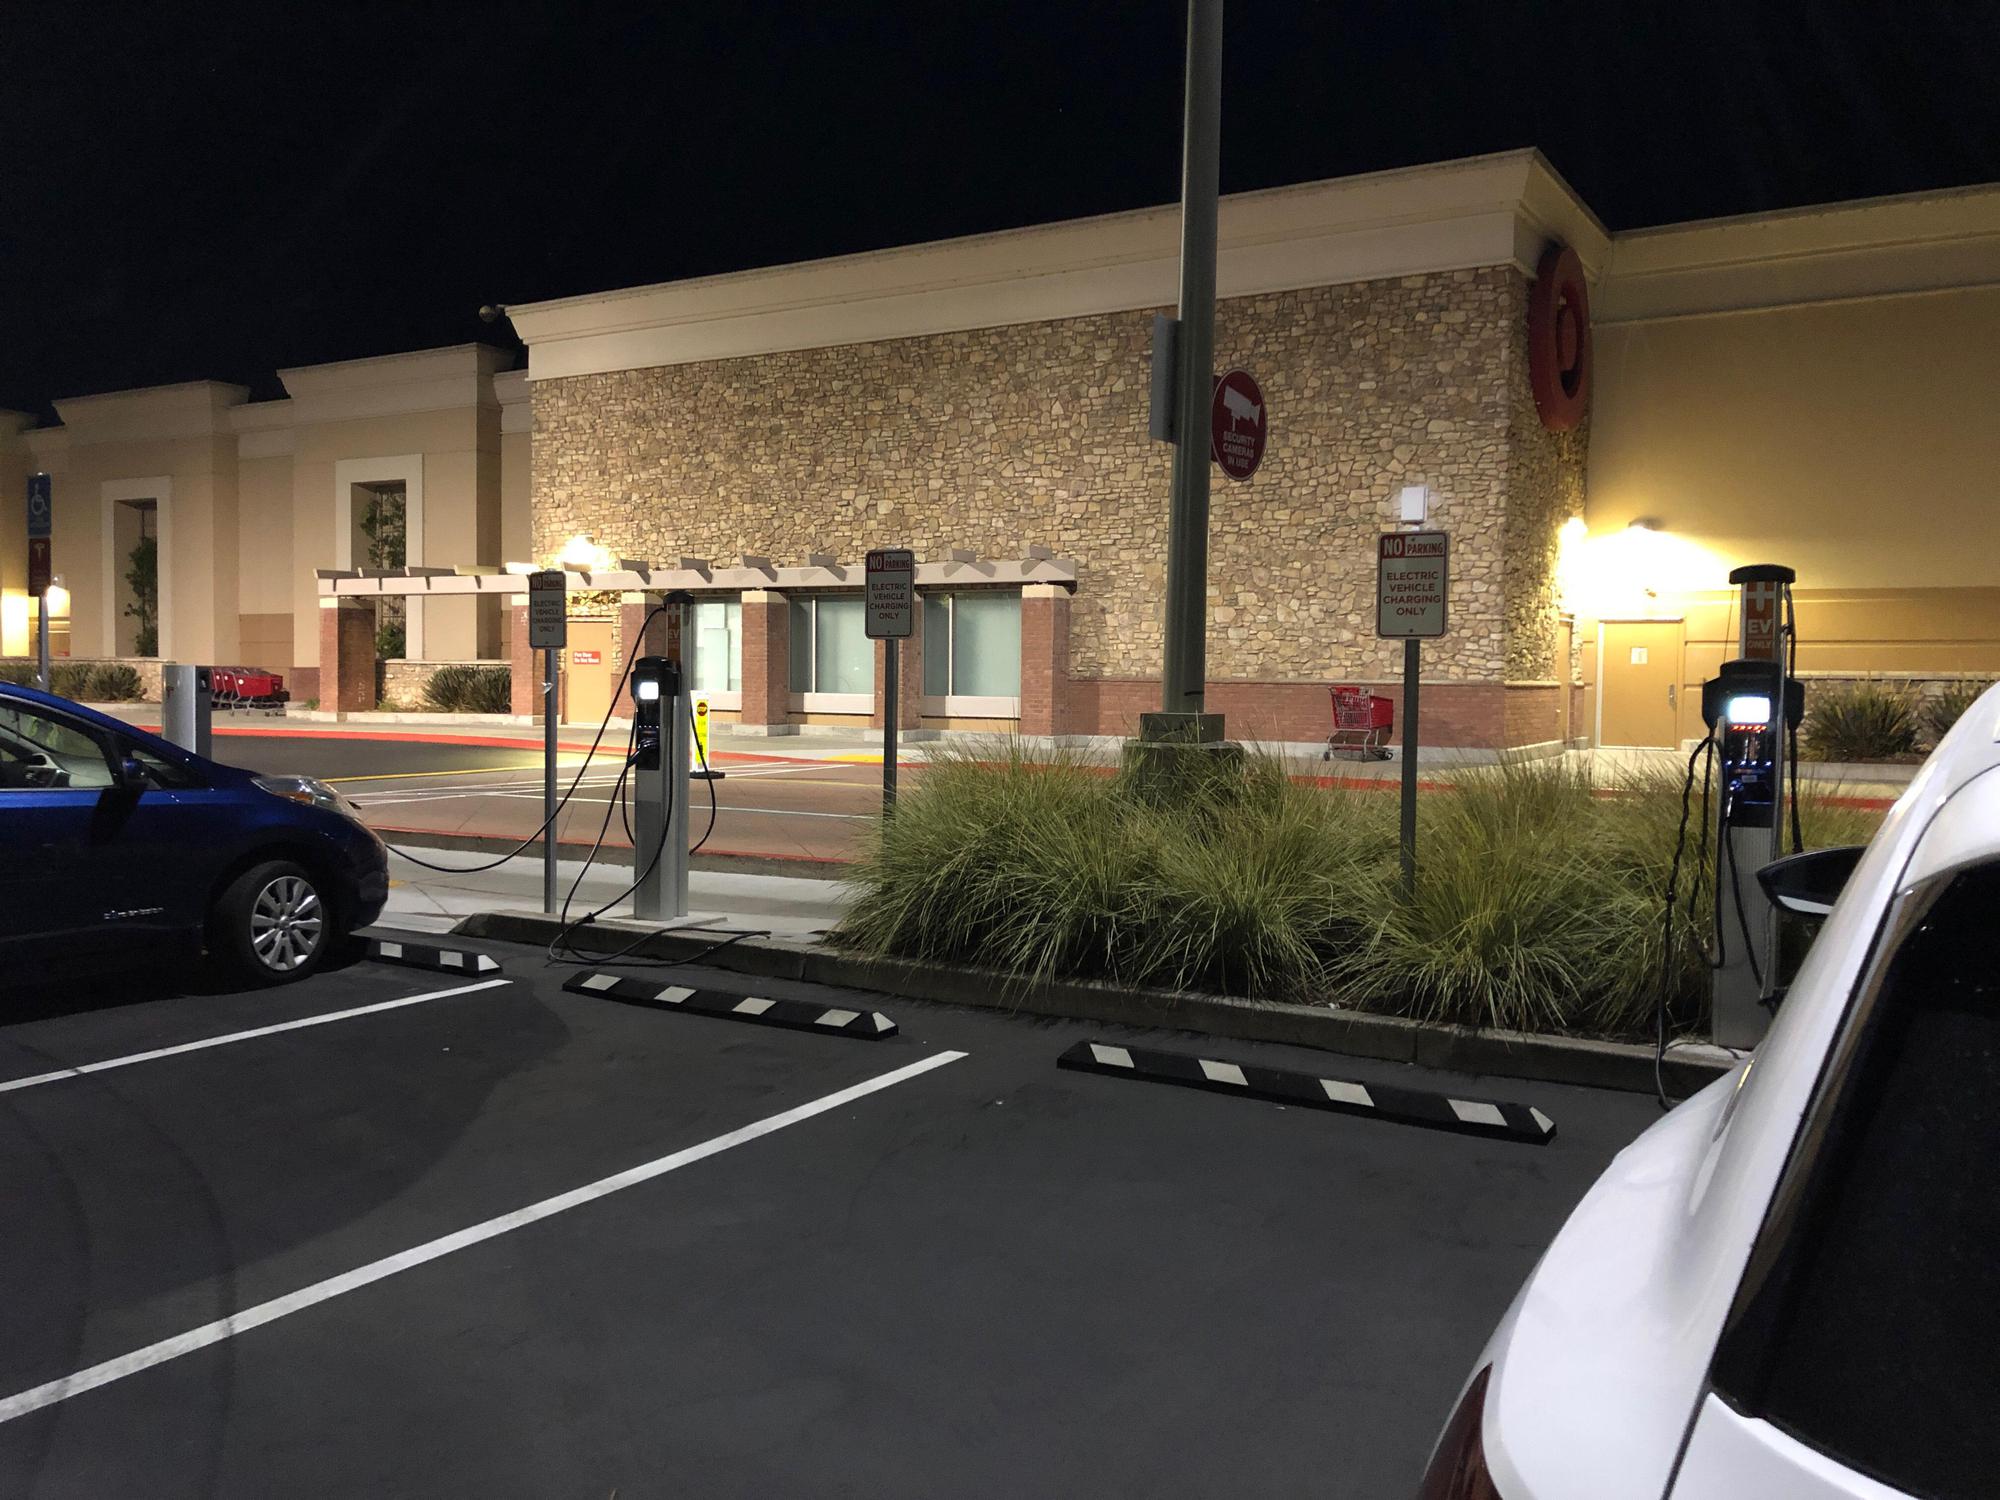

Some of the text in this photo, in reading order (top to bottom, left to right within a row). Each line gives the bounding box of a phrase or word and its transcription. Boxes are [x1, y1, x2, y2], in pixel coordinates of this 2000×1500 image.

[1223, 430, 1256, 447] SECURITY
[1222, 443, 1255, 459] CAMERAS
[1227, 455, 1249, 469] IN USE
[1384, 538, 1444, 555] NO PARKING
[869, 555, 910, 570] NO PARKING
[1386, 571, 1439, 581] ELECTRIC
[871, 583, 907, 591] ELECTRIC
[1389, 583, 1436, 593] VEHICLE
[873, 592, 905, 601] VEHICLE
[1382, 595, 1441, 605] CHARGING
[869, 602, 909, 610] CHARGING
[878, 612, 900, 620] ONLY
[1395, 607, 1427, 616] ONLY
[1747, 619, 1774, 634] EV
[668, 629, 680, 639] EV
[1746, 639, 1773, 649] ONLY
